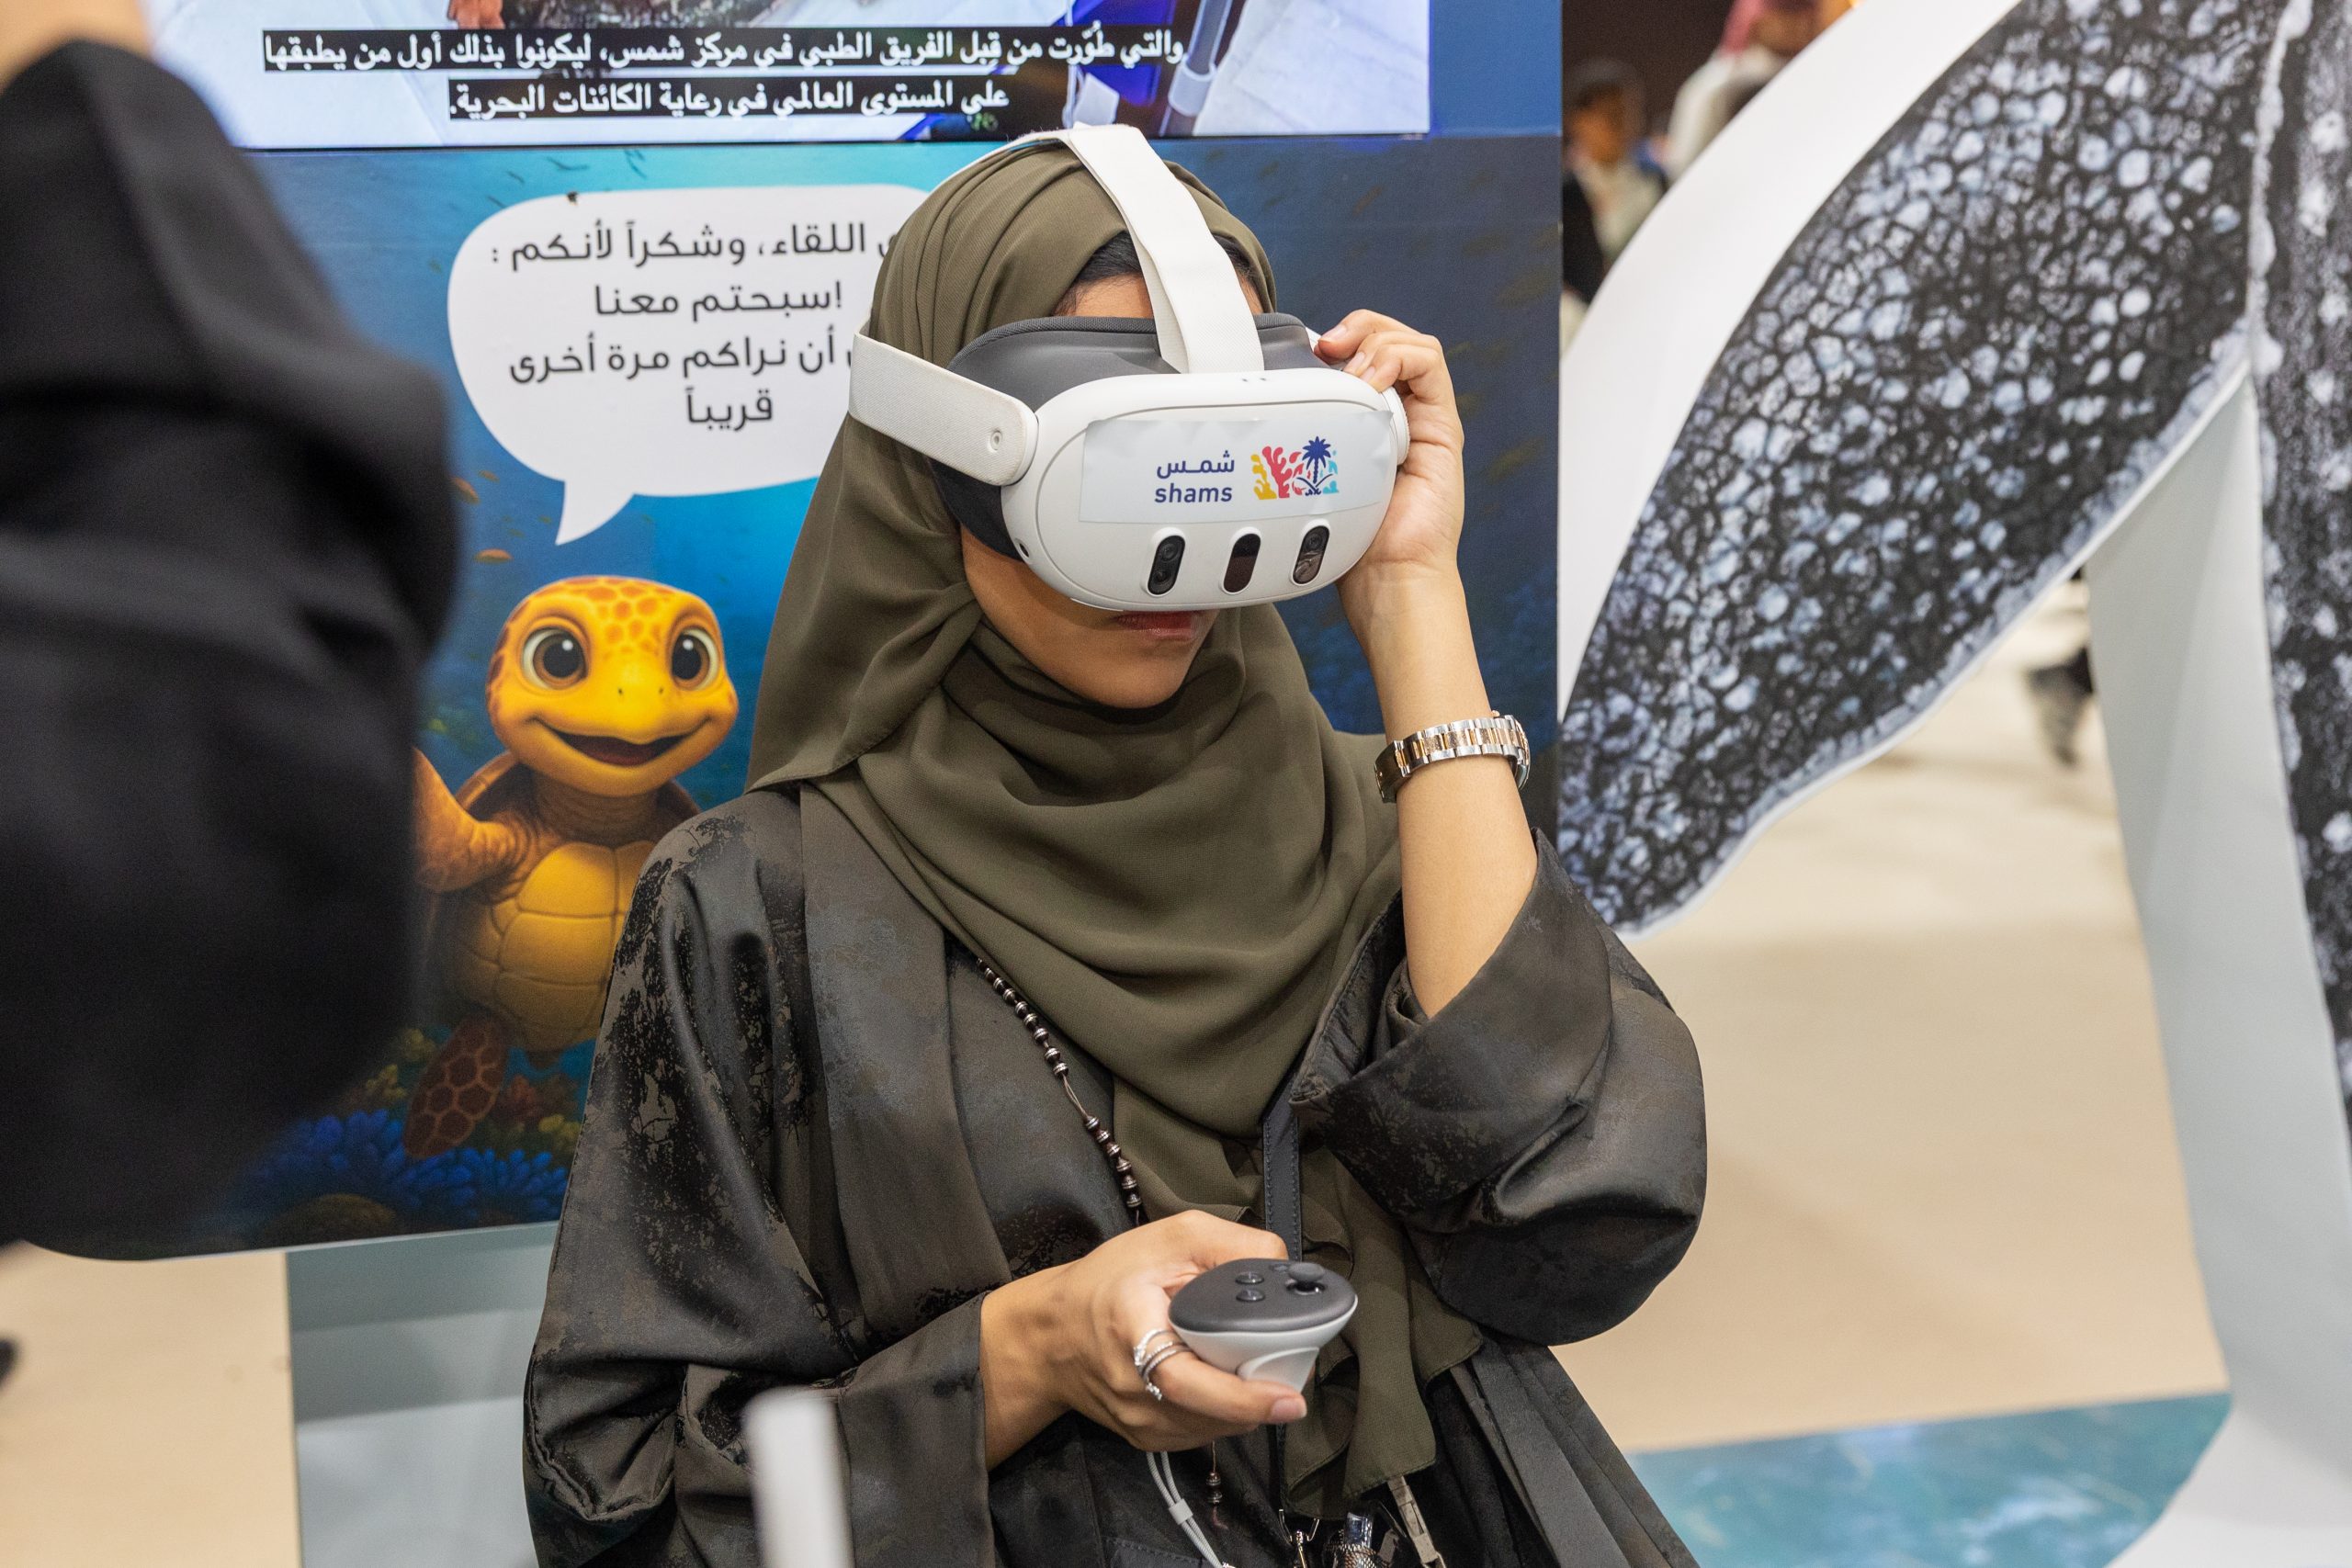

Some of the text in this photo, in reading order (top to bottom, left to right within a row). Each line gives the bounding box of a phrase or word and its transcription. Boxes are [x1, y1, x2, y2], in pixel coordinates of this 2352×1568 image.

[265, 34, 347, 71] يطبقها
[354, 42, 392, 71] من
[398, 31, 442, 70] أول
[449, 33, 505, 69] بذلك
[515, 32, 592, 69] ليكونوا
[600, 34, 684, 69] شمس،
[691, 31, 748, 68] مركز
[753, 32, 794, 69] في
[799, 30, 872, 68] الطبي
[879, 30, 953, 66] الفريق
[1007, 38, 1044, 65] من
[1120, 28, 1184, 69] والتي
[450, 79, 1010, 119] على المستوى العالمي في رعاية الكائنات البحرية.
[512, 218, 612, 272] لأنكم
[759, 222, 865, 255] اللقاء،
[595, 285, 679, 314] معنا
[510, 331, 595, 383] أخرى
[607, 344, 669, 379] مرة
[683, 335, 786, 378] نراكم
[799, 324, 834, 374] أن
[1157, 450, 1235, 479] شمس
[1154, 482, 1233, 503] shams
